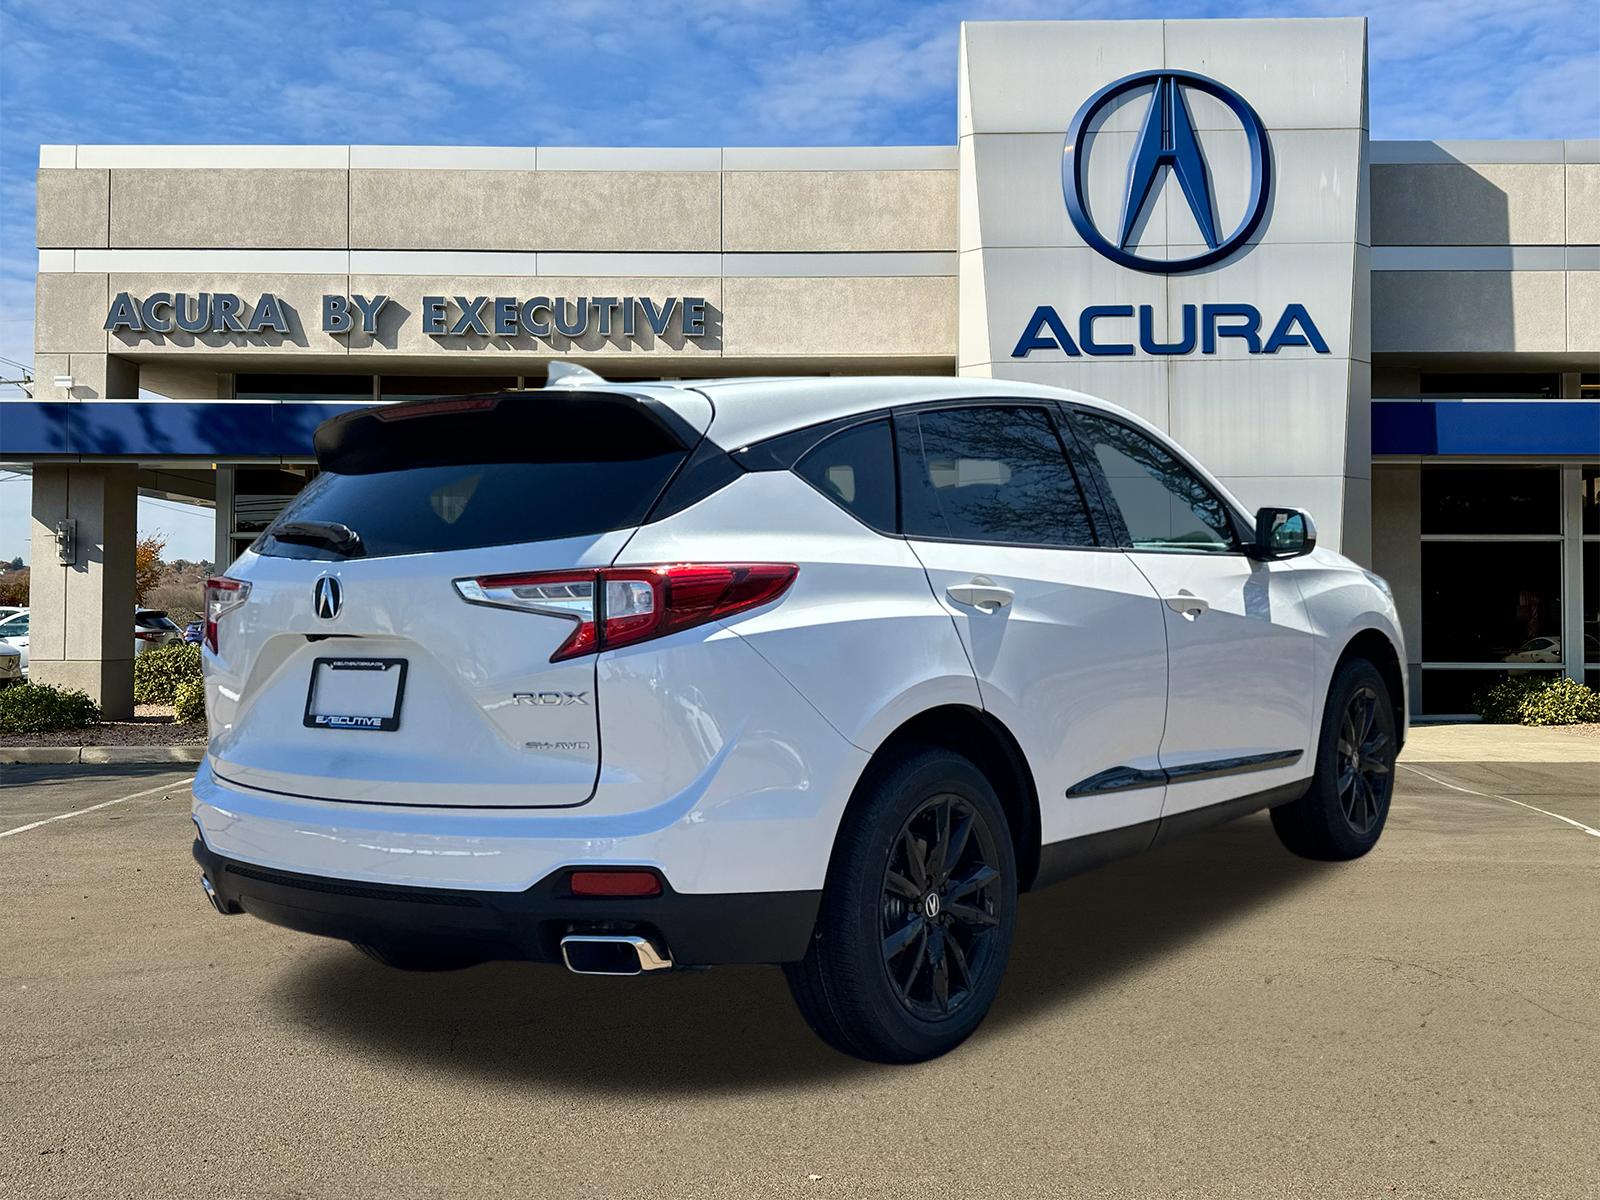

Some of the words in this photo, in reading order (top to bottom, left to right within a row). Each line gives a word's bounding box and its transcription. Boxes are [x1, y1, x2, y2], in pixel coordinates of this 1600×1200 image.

[103, 291, 290, 333] ACURA
[322, 294, 391, 334] BY
[422, 296, 706, 336] EXECUTIVE
[1010, 303, 1332, 357] ACURA
[512, 691, 590, 706] RDX
[315, 715, 382, 727] EXECUTIVE
[525, 741, 590, 750] SH-AWD
